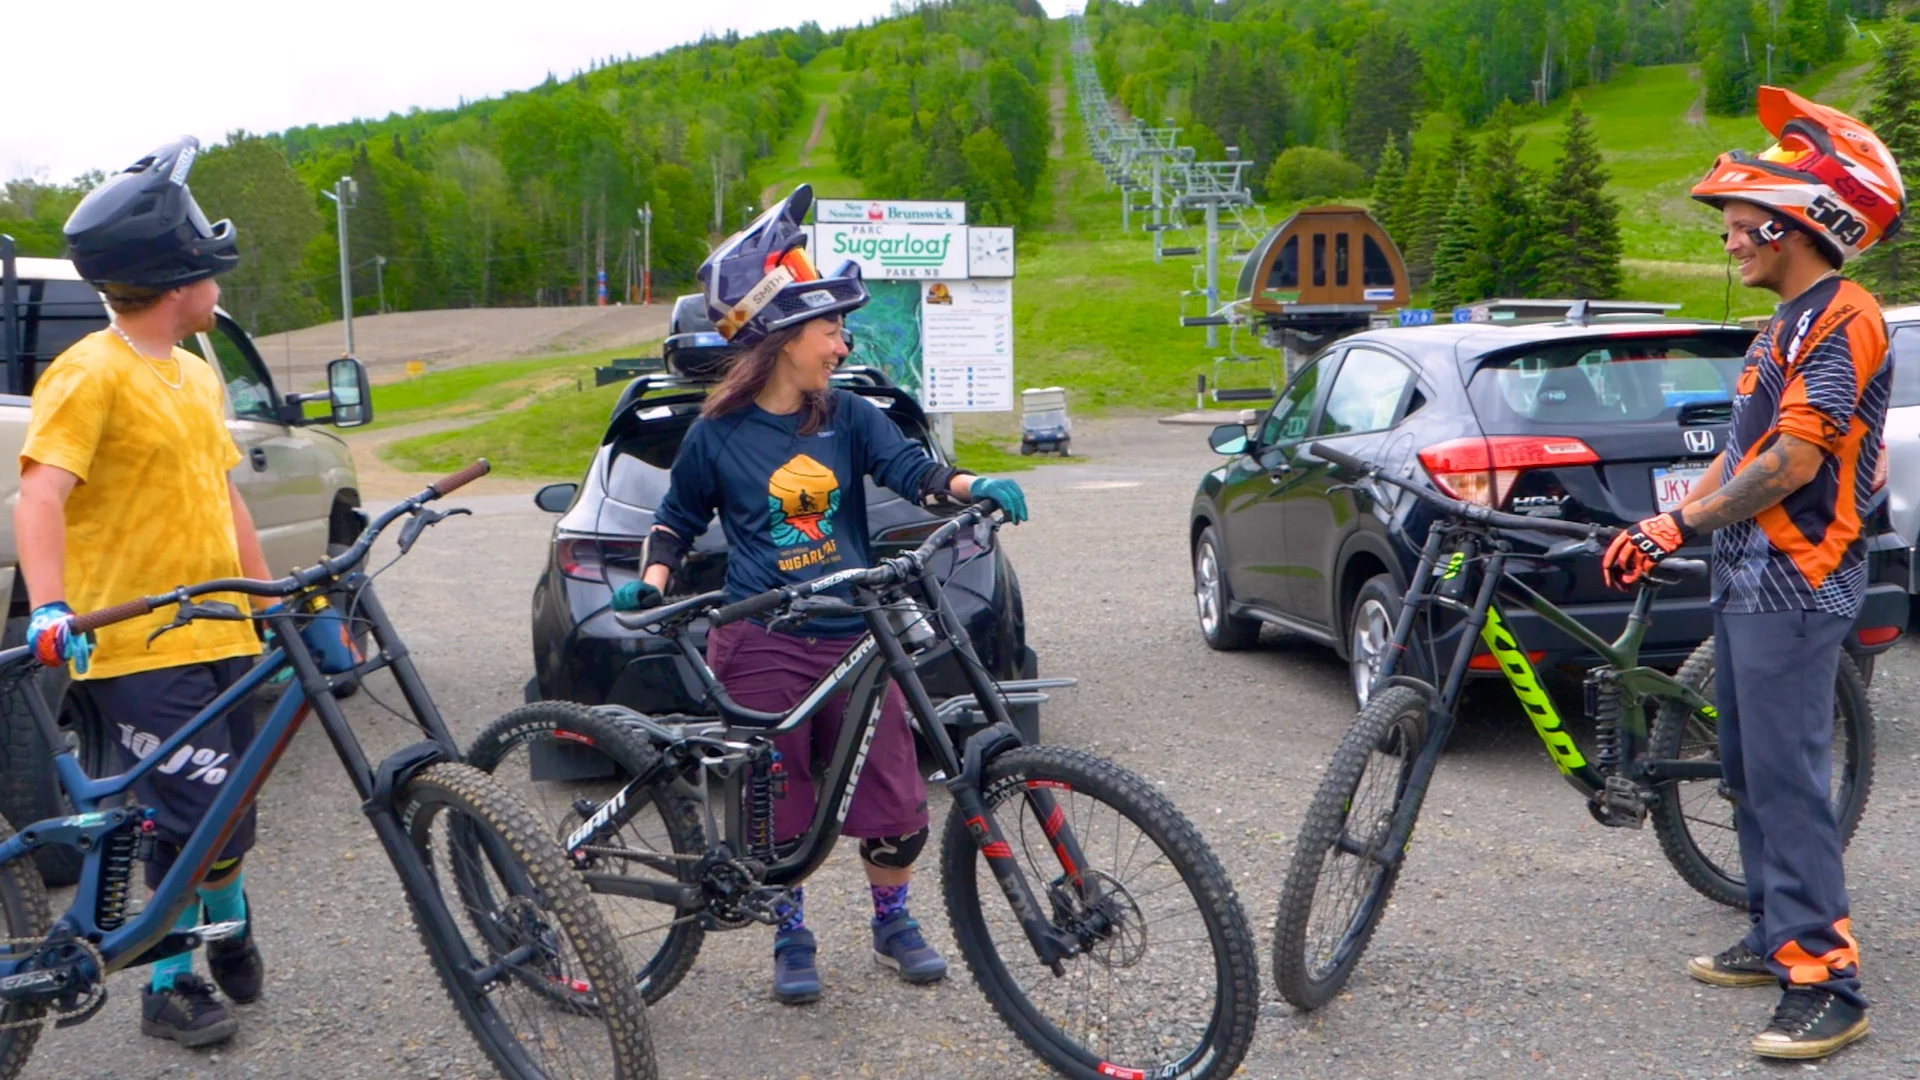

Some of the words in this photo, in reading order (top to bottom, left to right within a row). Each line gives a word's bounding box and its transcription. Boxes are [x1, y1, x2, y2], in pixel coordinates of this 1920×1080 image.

[888, 206, 953, 219] Brunswick
[1805, 195, 1867, 246] 509
[852, 226, 882, 234] PARC
[833, 231, 952, 260] Sugarloaf
[886, 268, 916, 276] PARK
[924, 268, 940, 276] NB
[752, 274, 785, 305] SMITH
[1512, 494, 1571, 506] HR-V
[777, 539, 837, 571] SUGARLAF
[1630, 532, 1664, 561] FOX
[833, 634, 875, 681] GLORY
[836, 696, 883, 824] GIANT
[567, 786, 629, 850] GIANT
